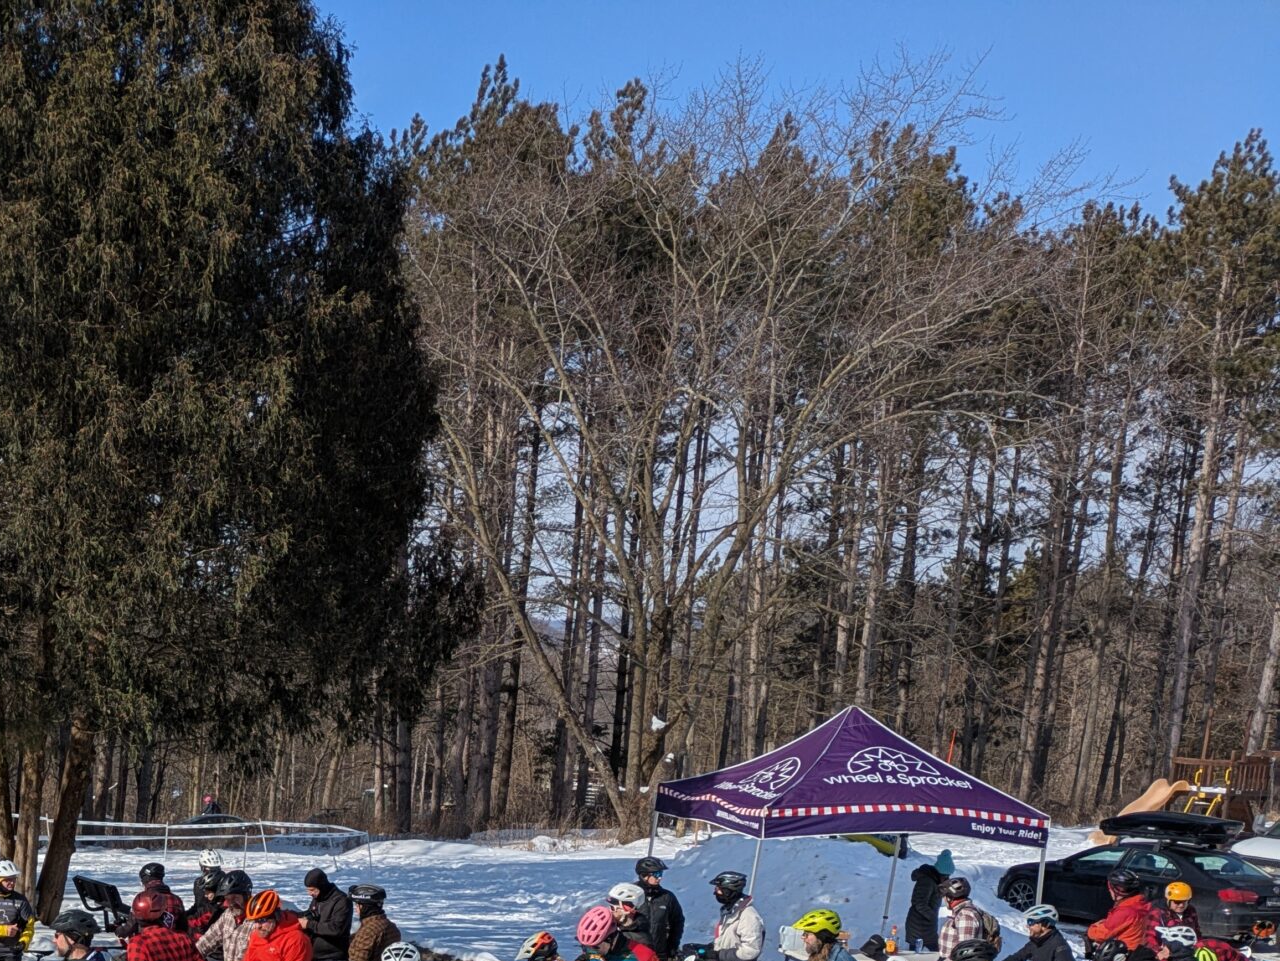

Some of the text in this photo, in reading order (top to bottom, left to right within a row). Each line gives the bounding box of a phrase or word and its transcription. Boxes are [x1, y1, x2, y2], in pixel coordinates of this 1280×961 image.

[823, 772, 973, 790] wheel & Sprocket
[971, 822, 996, 835] Enjoy
[1018, 829, 1042, 840] Ride!
